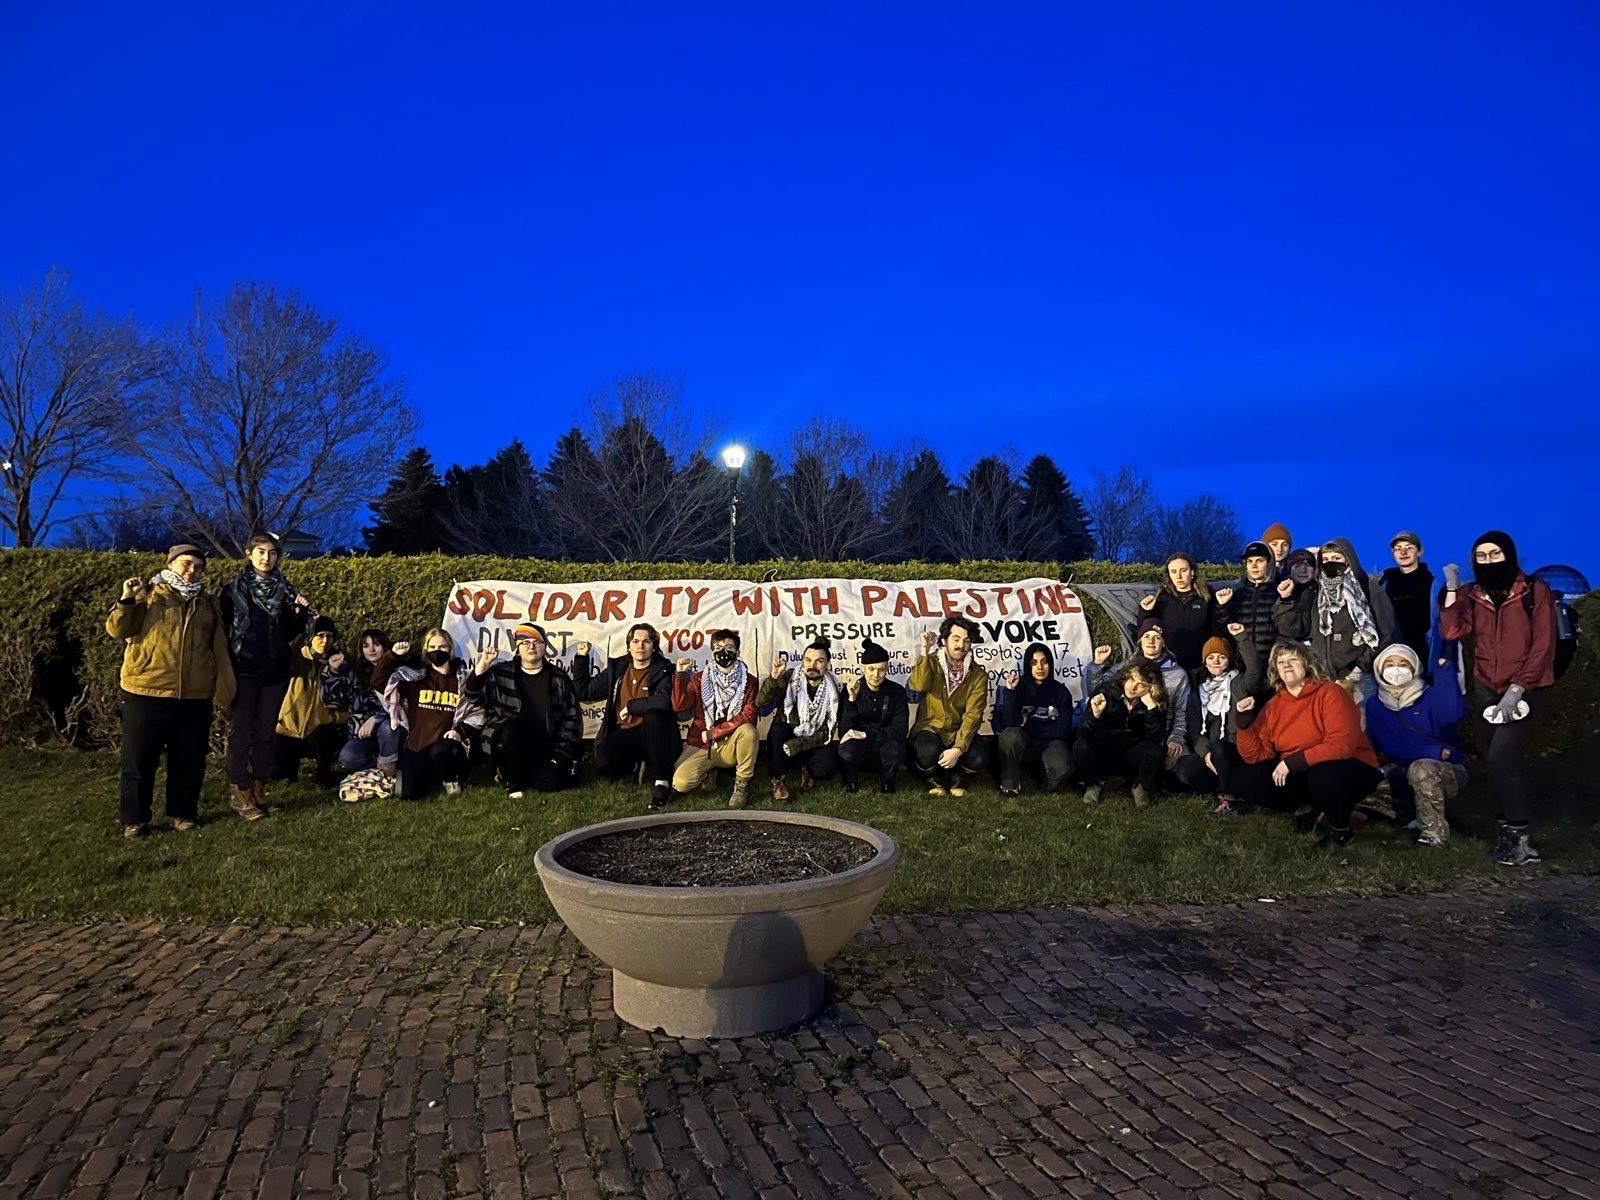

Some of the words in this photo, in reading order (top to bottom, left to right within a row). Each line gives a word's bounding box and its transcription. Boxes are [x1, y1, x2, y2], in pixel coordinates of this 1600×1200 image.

[449, 586, 710, 622] SOLIDARITY
[732, 585, 840, 617] WITH
[861, 584, 1083, 618] PALESTINE
[791, 622, 896, 640] PRESSURE
[971, 620, 1061, 643] EVOKE
[477, 626, 573, 657] DIVST
[831, 649, 847, 660] ust
[971, 643, 1023, 661] esota's
[1055, 658, 1084, 678] vest
